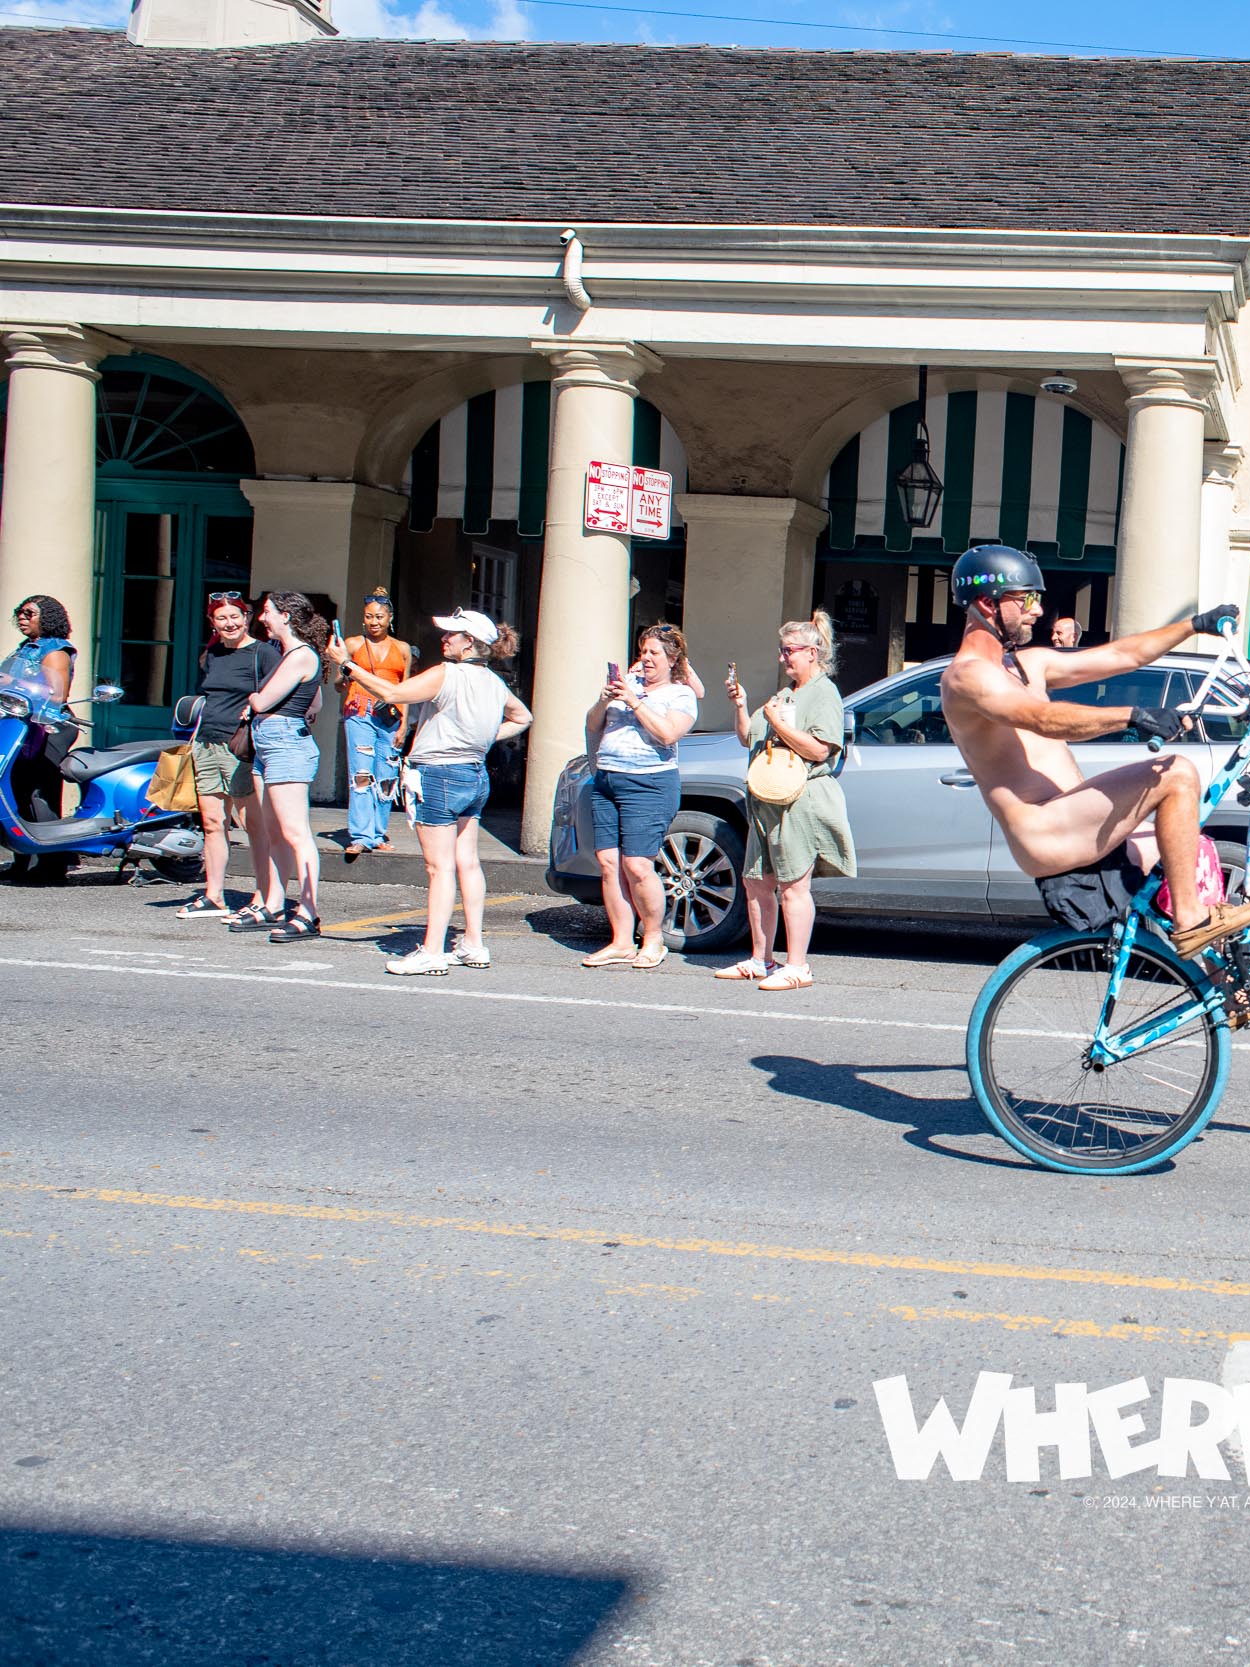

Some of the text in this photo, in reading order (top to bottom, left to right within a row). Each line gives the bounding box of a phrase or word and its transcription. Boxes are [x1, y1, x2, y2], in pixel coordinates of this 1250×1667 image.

[589, 466, 628, 482] NO STOPPING
[633, 472, 669, 489] NO STOPPING
[640, 493, 662, 507] ANY
[639, 504, 662, 519] TIME
